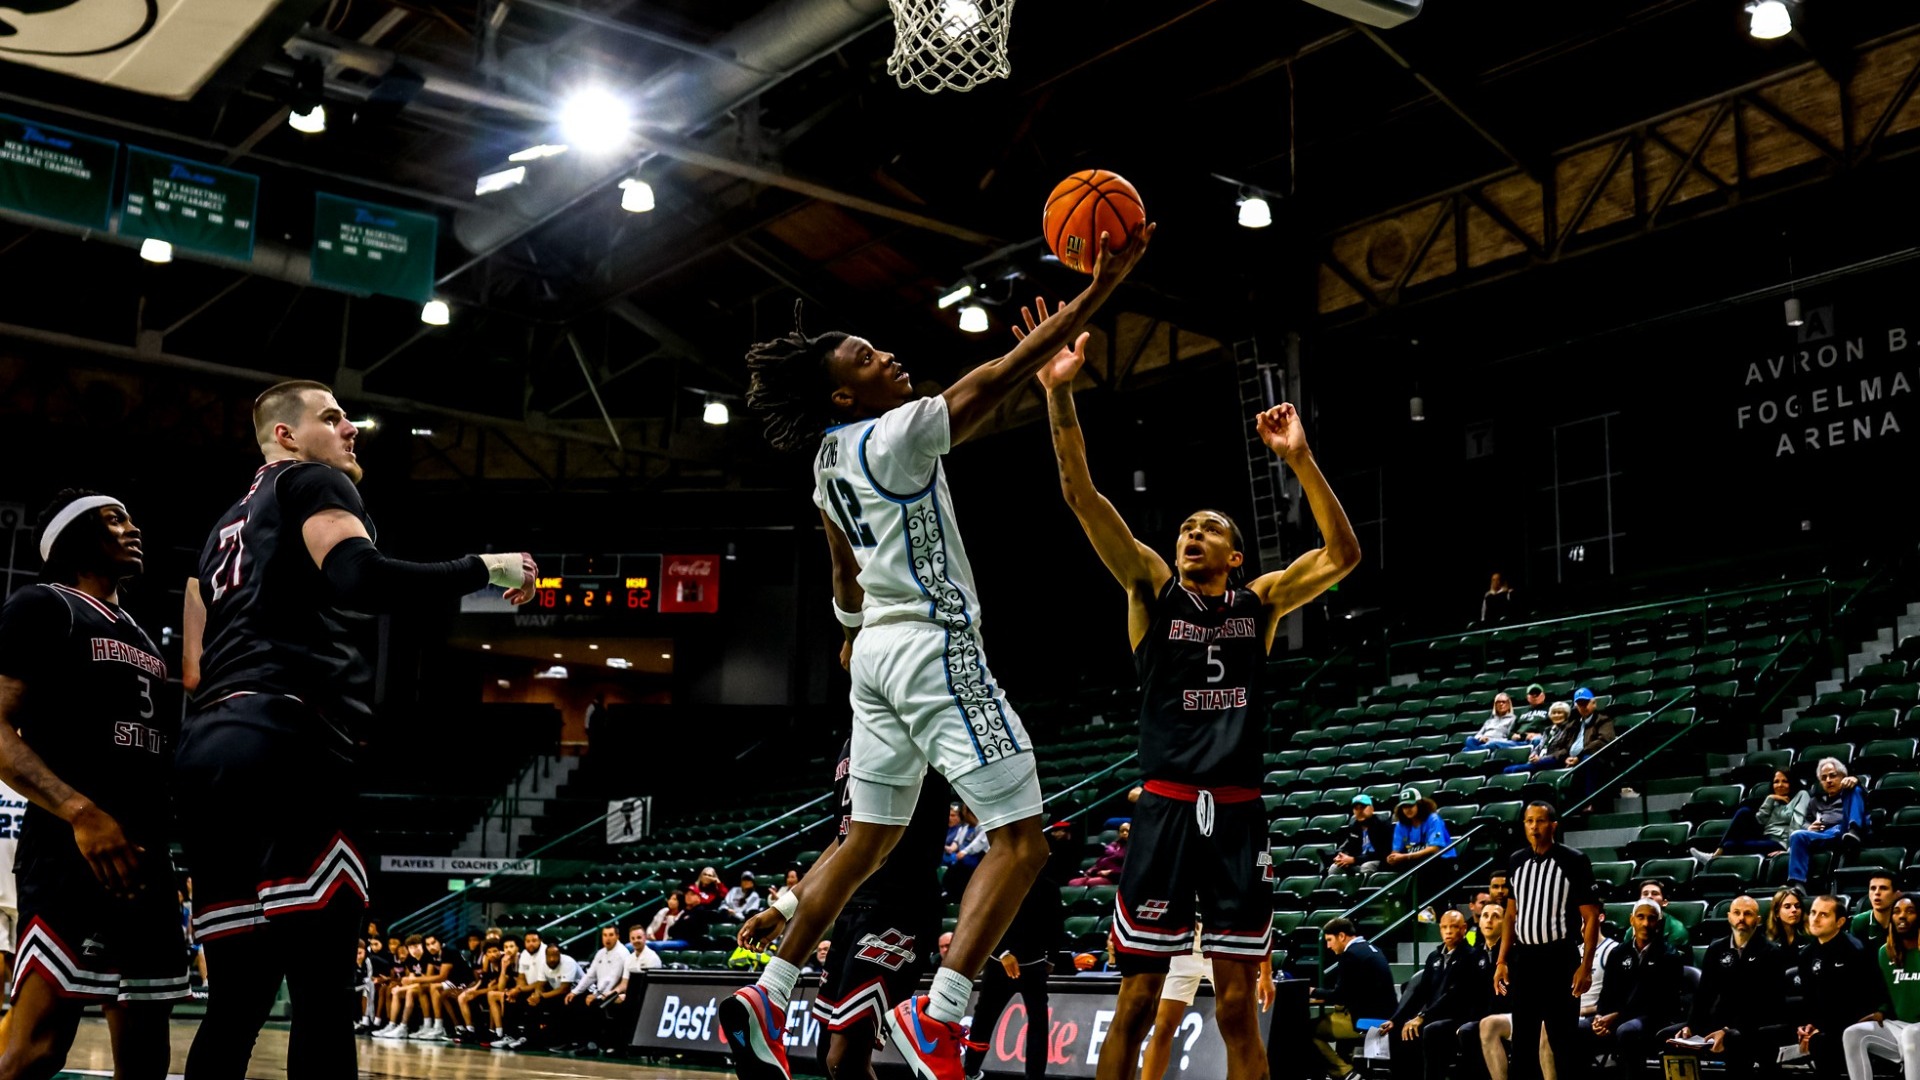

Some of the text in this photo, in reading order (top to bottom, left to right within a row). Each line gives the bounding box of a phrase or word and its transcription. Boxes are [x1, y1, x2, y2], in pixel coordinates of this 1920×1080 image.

[1745, 337, 1864, 386] AVRON
[1737, 367, 1920, 429] FOGELMA
[1776, 411, 1901, 457] ARENA
[826, 478, 878, 548] 12
[535, 577, 648, 589] LANE HSU
[583, 590, 595, 608] 2
[627, 590, 650, 609] 62
[91, 637, 167, 680] HENDERS
[1206, 645, 1225, 683] 5
[137, 674, 154, 719] 3
[1182, 686, 1247, 711] STATE
[390, 859, 434, 869] PLAYERS
[451, 860, 499, 870] COACHES
[1892, 968, 1920, 984] TULA
[656, 994, 717, 1042] Best
